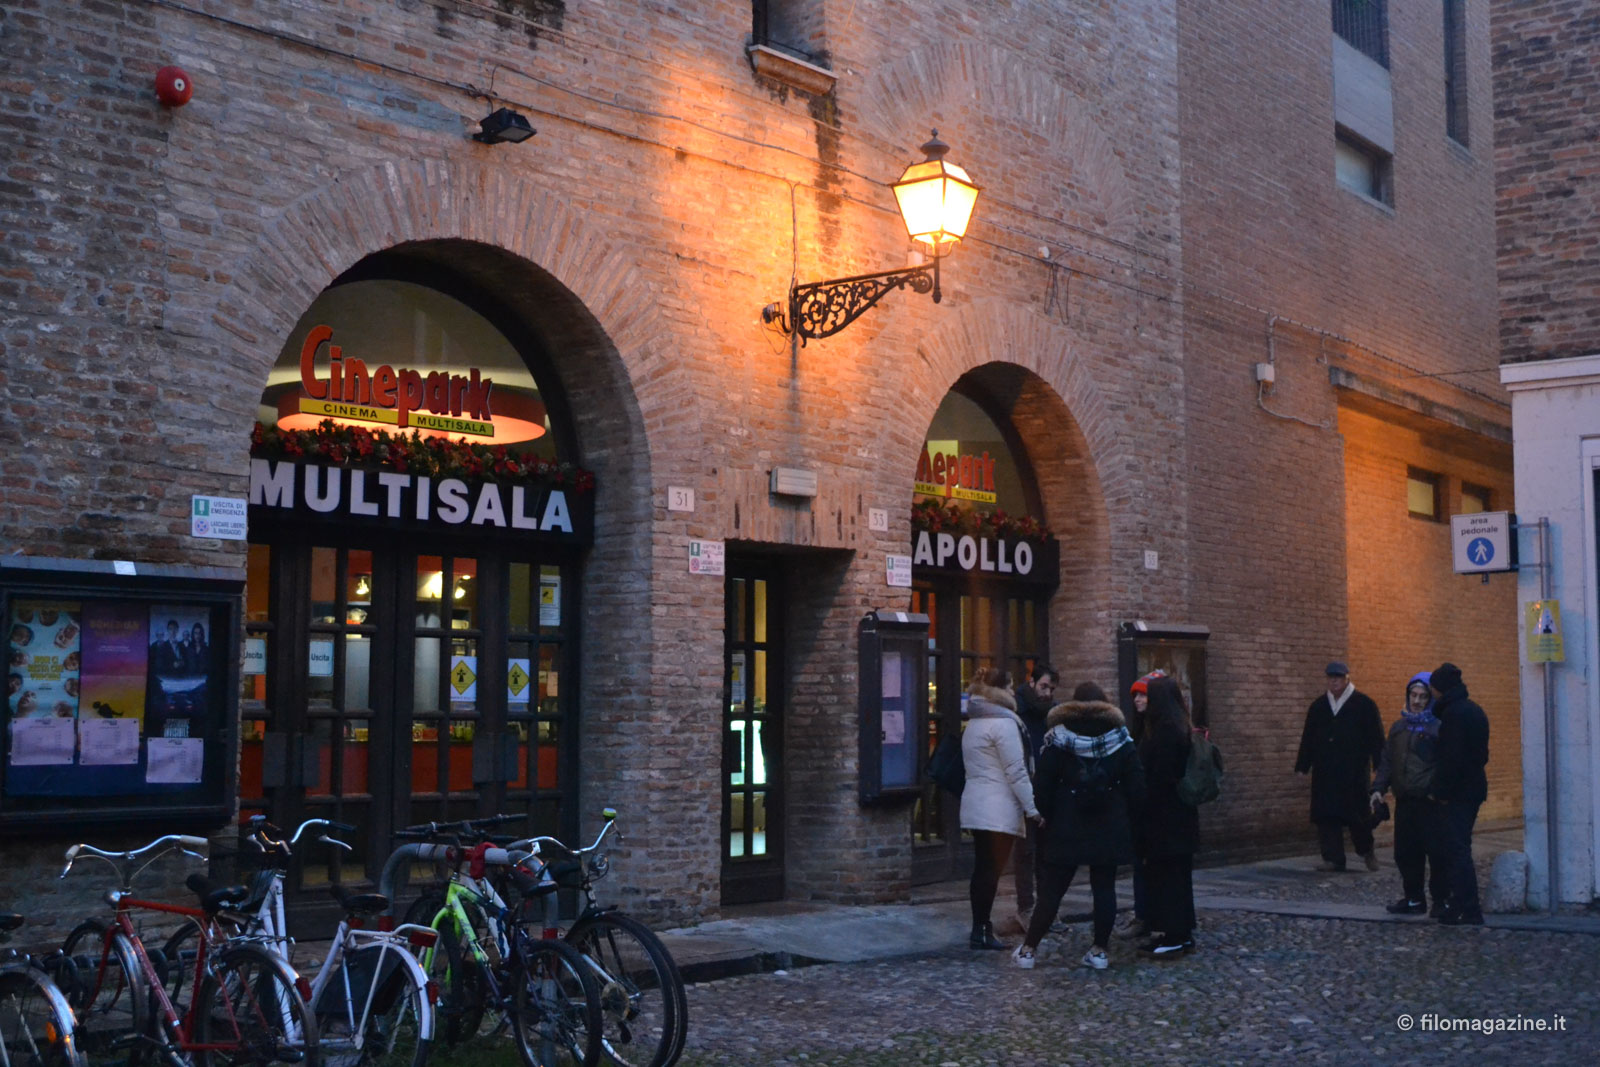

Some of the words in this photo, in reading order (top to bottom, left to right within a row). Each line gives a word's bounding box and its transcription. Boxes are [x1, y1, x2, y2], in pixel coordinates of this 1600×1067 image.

[300, 324, 492, 429] Cinepark
[323, 402, 379, 419] CINEMA
[416, 415, 487, 434] MULTISALA
[249, 457, 574, 533] MULTISALA
[675, 491, 688, 507] 31
[955, 489, 994, 502] MULTISALA
[210, 507, 245, 516] EMERGENZA
[213, 501, 235, 509] USCITA
[1470, 517, 1489, 525] area
[1461, 525, 1499, 537] pedonale
[913, 530, 1033, 576] APOLLO
[311, 652, 330, 662] Uscita
